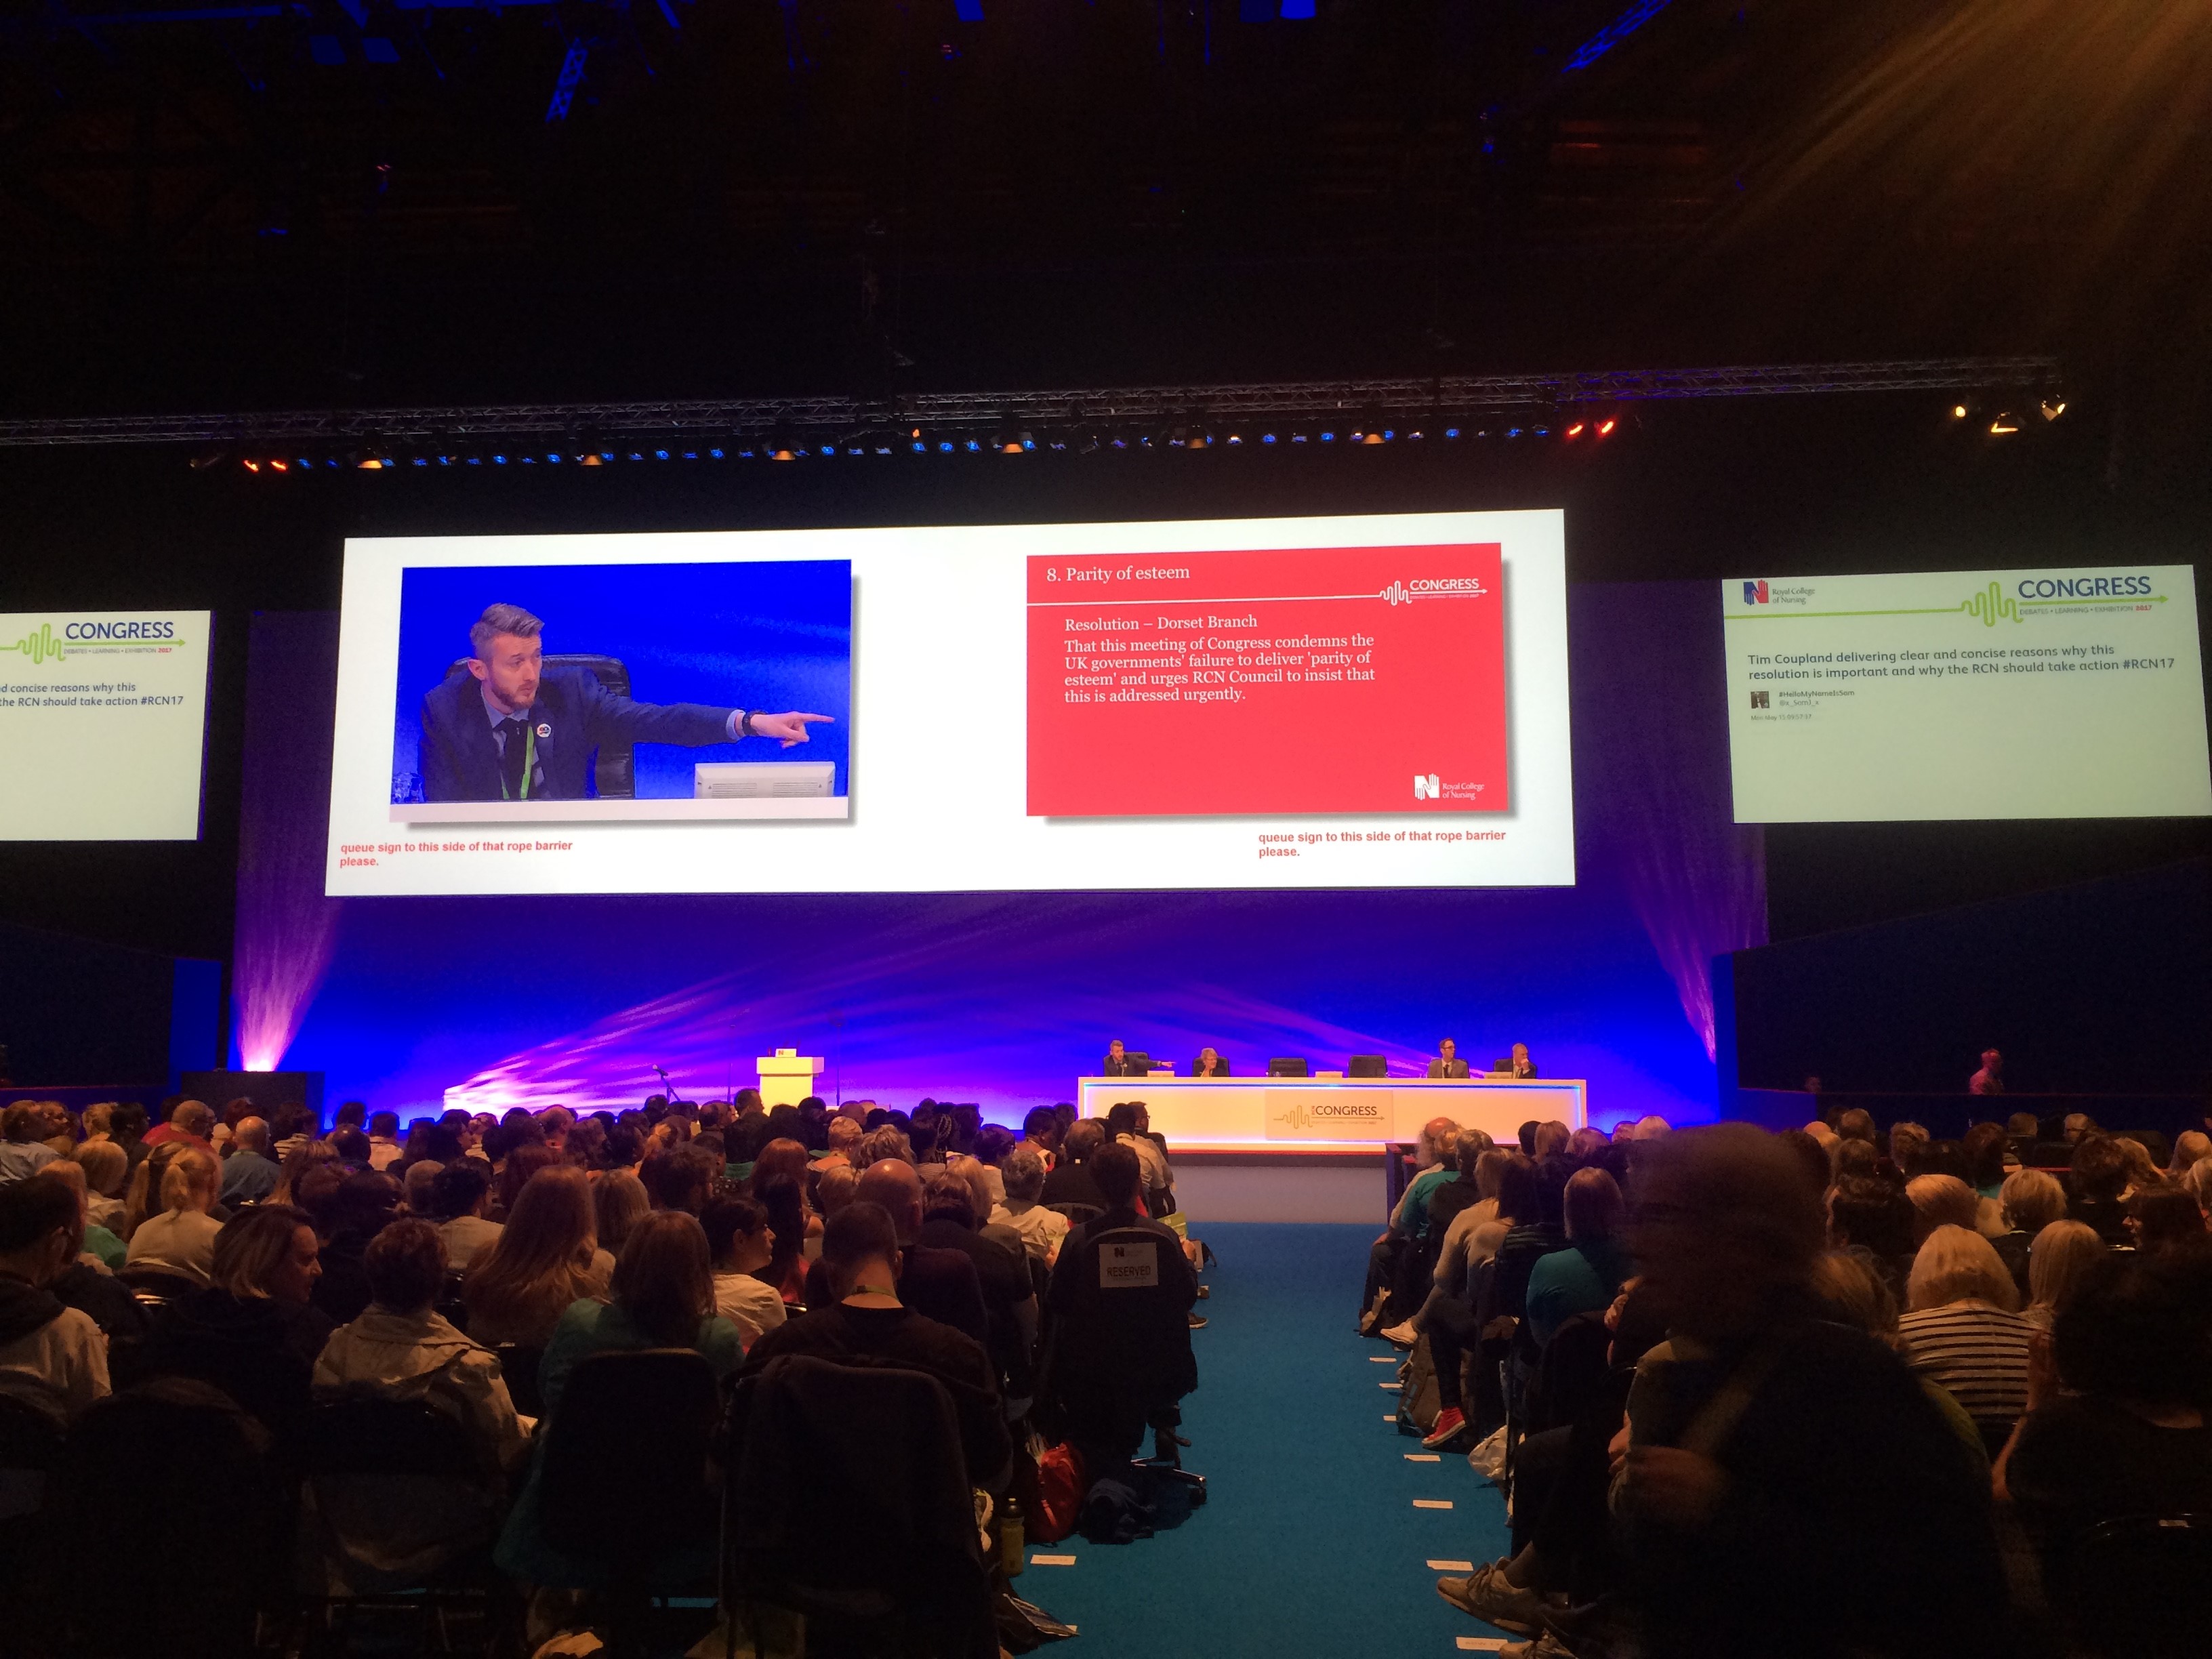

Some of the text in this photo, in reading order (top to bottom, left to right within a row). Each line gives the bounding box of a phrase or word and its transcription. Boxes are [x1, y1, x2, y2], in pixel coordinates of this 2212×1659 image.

[1046, 565, 1190, 584] 8. Parity of esteem
[1410, 578, 1479, 590] CONGRESS
[2018, 576, 2152, 598] CONGRESS
[1791, 588, 1815, 596] College
[1781, 597, 1806, 605] Nursing
[1065, 617, 1139, 631] Resolution
[1158, 616, 1204, 630] Dorset
[1208, 614, 1258, 628] Branch
[66, 621, 173, 639] CONGRESS
[1064, 633, 1374, 653] That this meeting of Congress condemns the
[1065, 650, 1372, 672] UK governments' failure to deliver 'parity of
[1748, 644, 2114, 665] Tim Coupland delivering clear and concise reasons why this
[1749, 658, 2175, 680] resolution is important and why the RCN should take action #RCN17
[1065, 668, 1375, 687] esteem' and urges RCN Council to insist that
[10, 684, 47, 693] concise
[93, 682, 112, 694] why
[117, 682, 136, 692] this
[18, 697, 39, 706] RCN
[43, 697, 77, 706] should
[80, 697, 102, 705] take
[105, 697, 138, 705] action
[141, 696, 183, 705] #RCN17
[1064, 687, 1246, 703] this is addressed urgently.
[1442, 782, 1485, 792] Royal College
[1451, 792, 1475, 800] Nursing
[1258, 831, 1506, 844] queue sign to this side of that rope barrier
[341, 841, 573, 854] queue sign to this side of that rope barrier
[1258, 847, 1300, 859] please.
[340, 857, 379, 868] please.
[1315, 1105, 1377, 1115] CONGRESS
[1107, 1265, 1151, 1277] RESERVED
